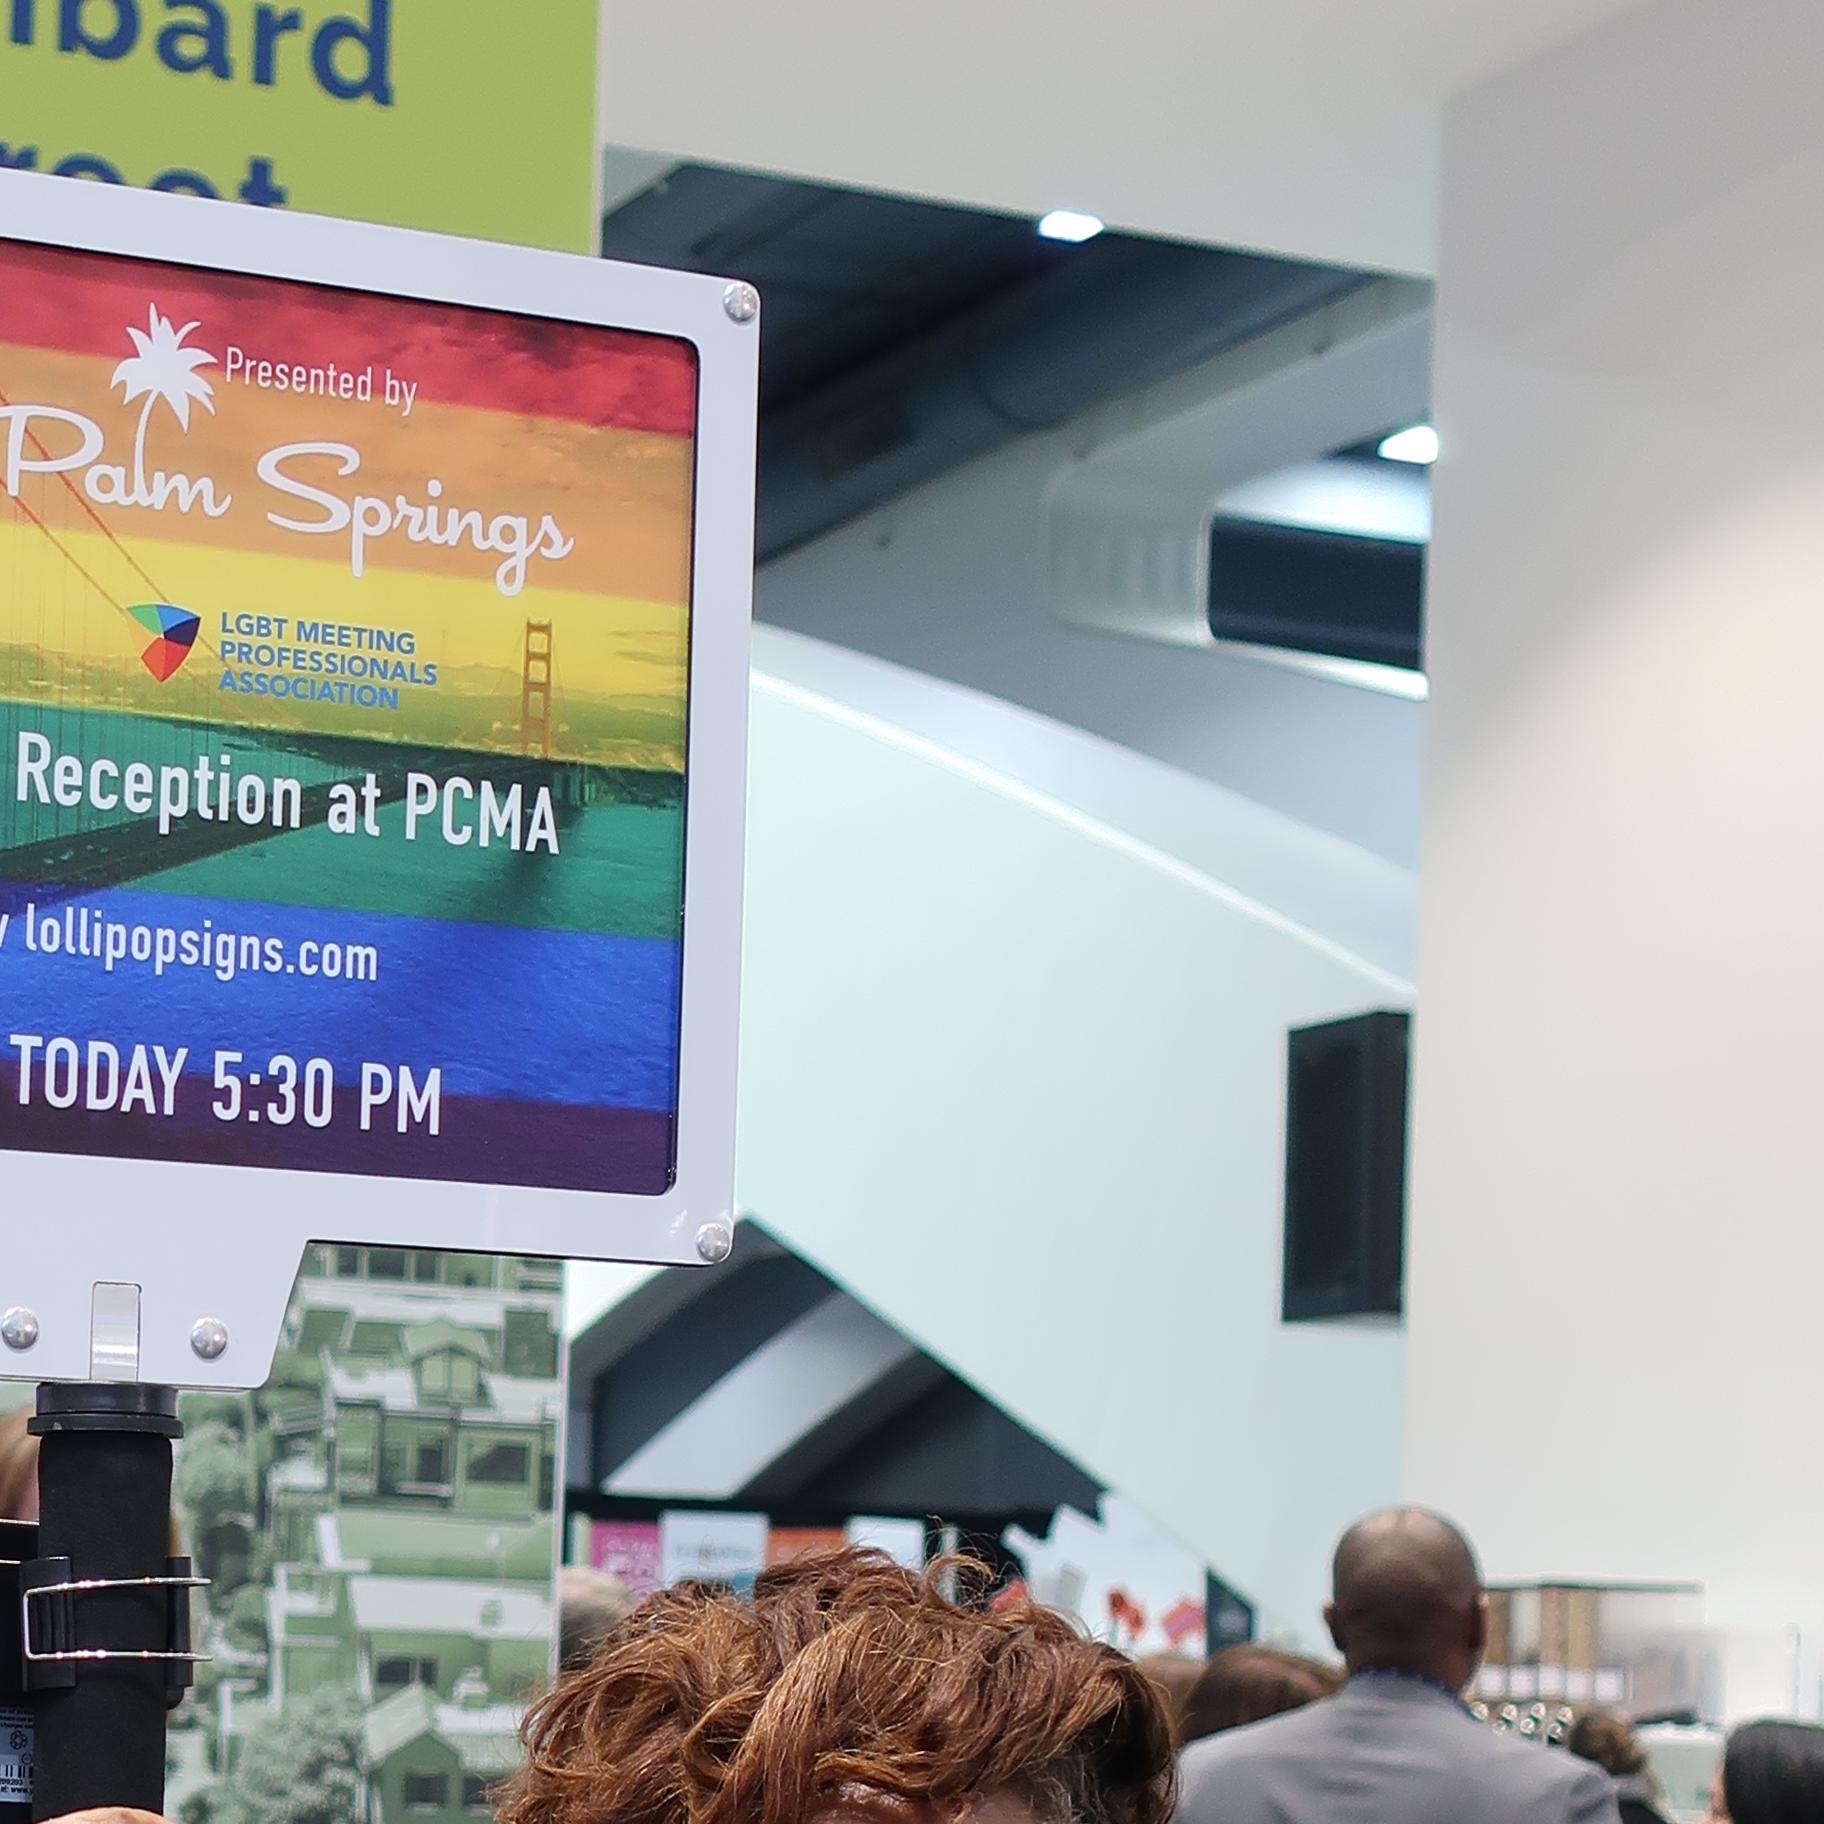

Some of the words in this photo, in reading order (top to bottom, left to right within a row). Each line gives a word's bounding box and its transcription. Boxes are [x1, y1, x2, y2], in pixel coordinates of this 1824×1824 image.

[226, 347, 372, 403] Presented
[384, 369, 418, 418] by
[256, 441, 575, 597] Springs
[219, 640, 438, 687] PROFESSIONALS
[221, 611, 288, 641] LGBT
[296, 618, 416, 656] MEETING
[218, 669, 399, 710] ASSOCIATION
[17, 731, 302, 835] Reception
[327, 773, 381, 837] at
[405, 772, 561, 855] PCMA
[26, 902, 378, 981] lollipopsigns.com
[9, 1034, 189, 1116] TODAY
[212, 1050, 334, 1127] 5:30
[360, 1062, 442, 1135] PM
